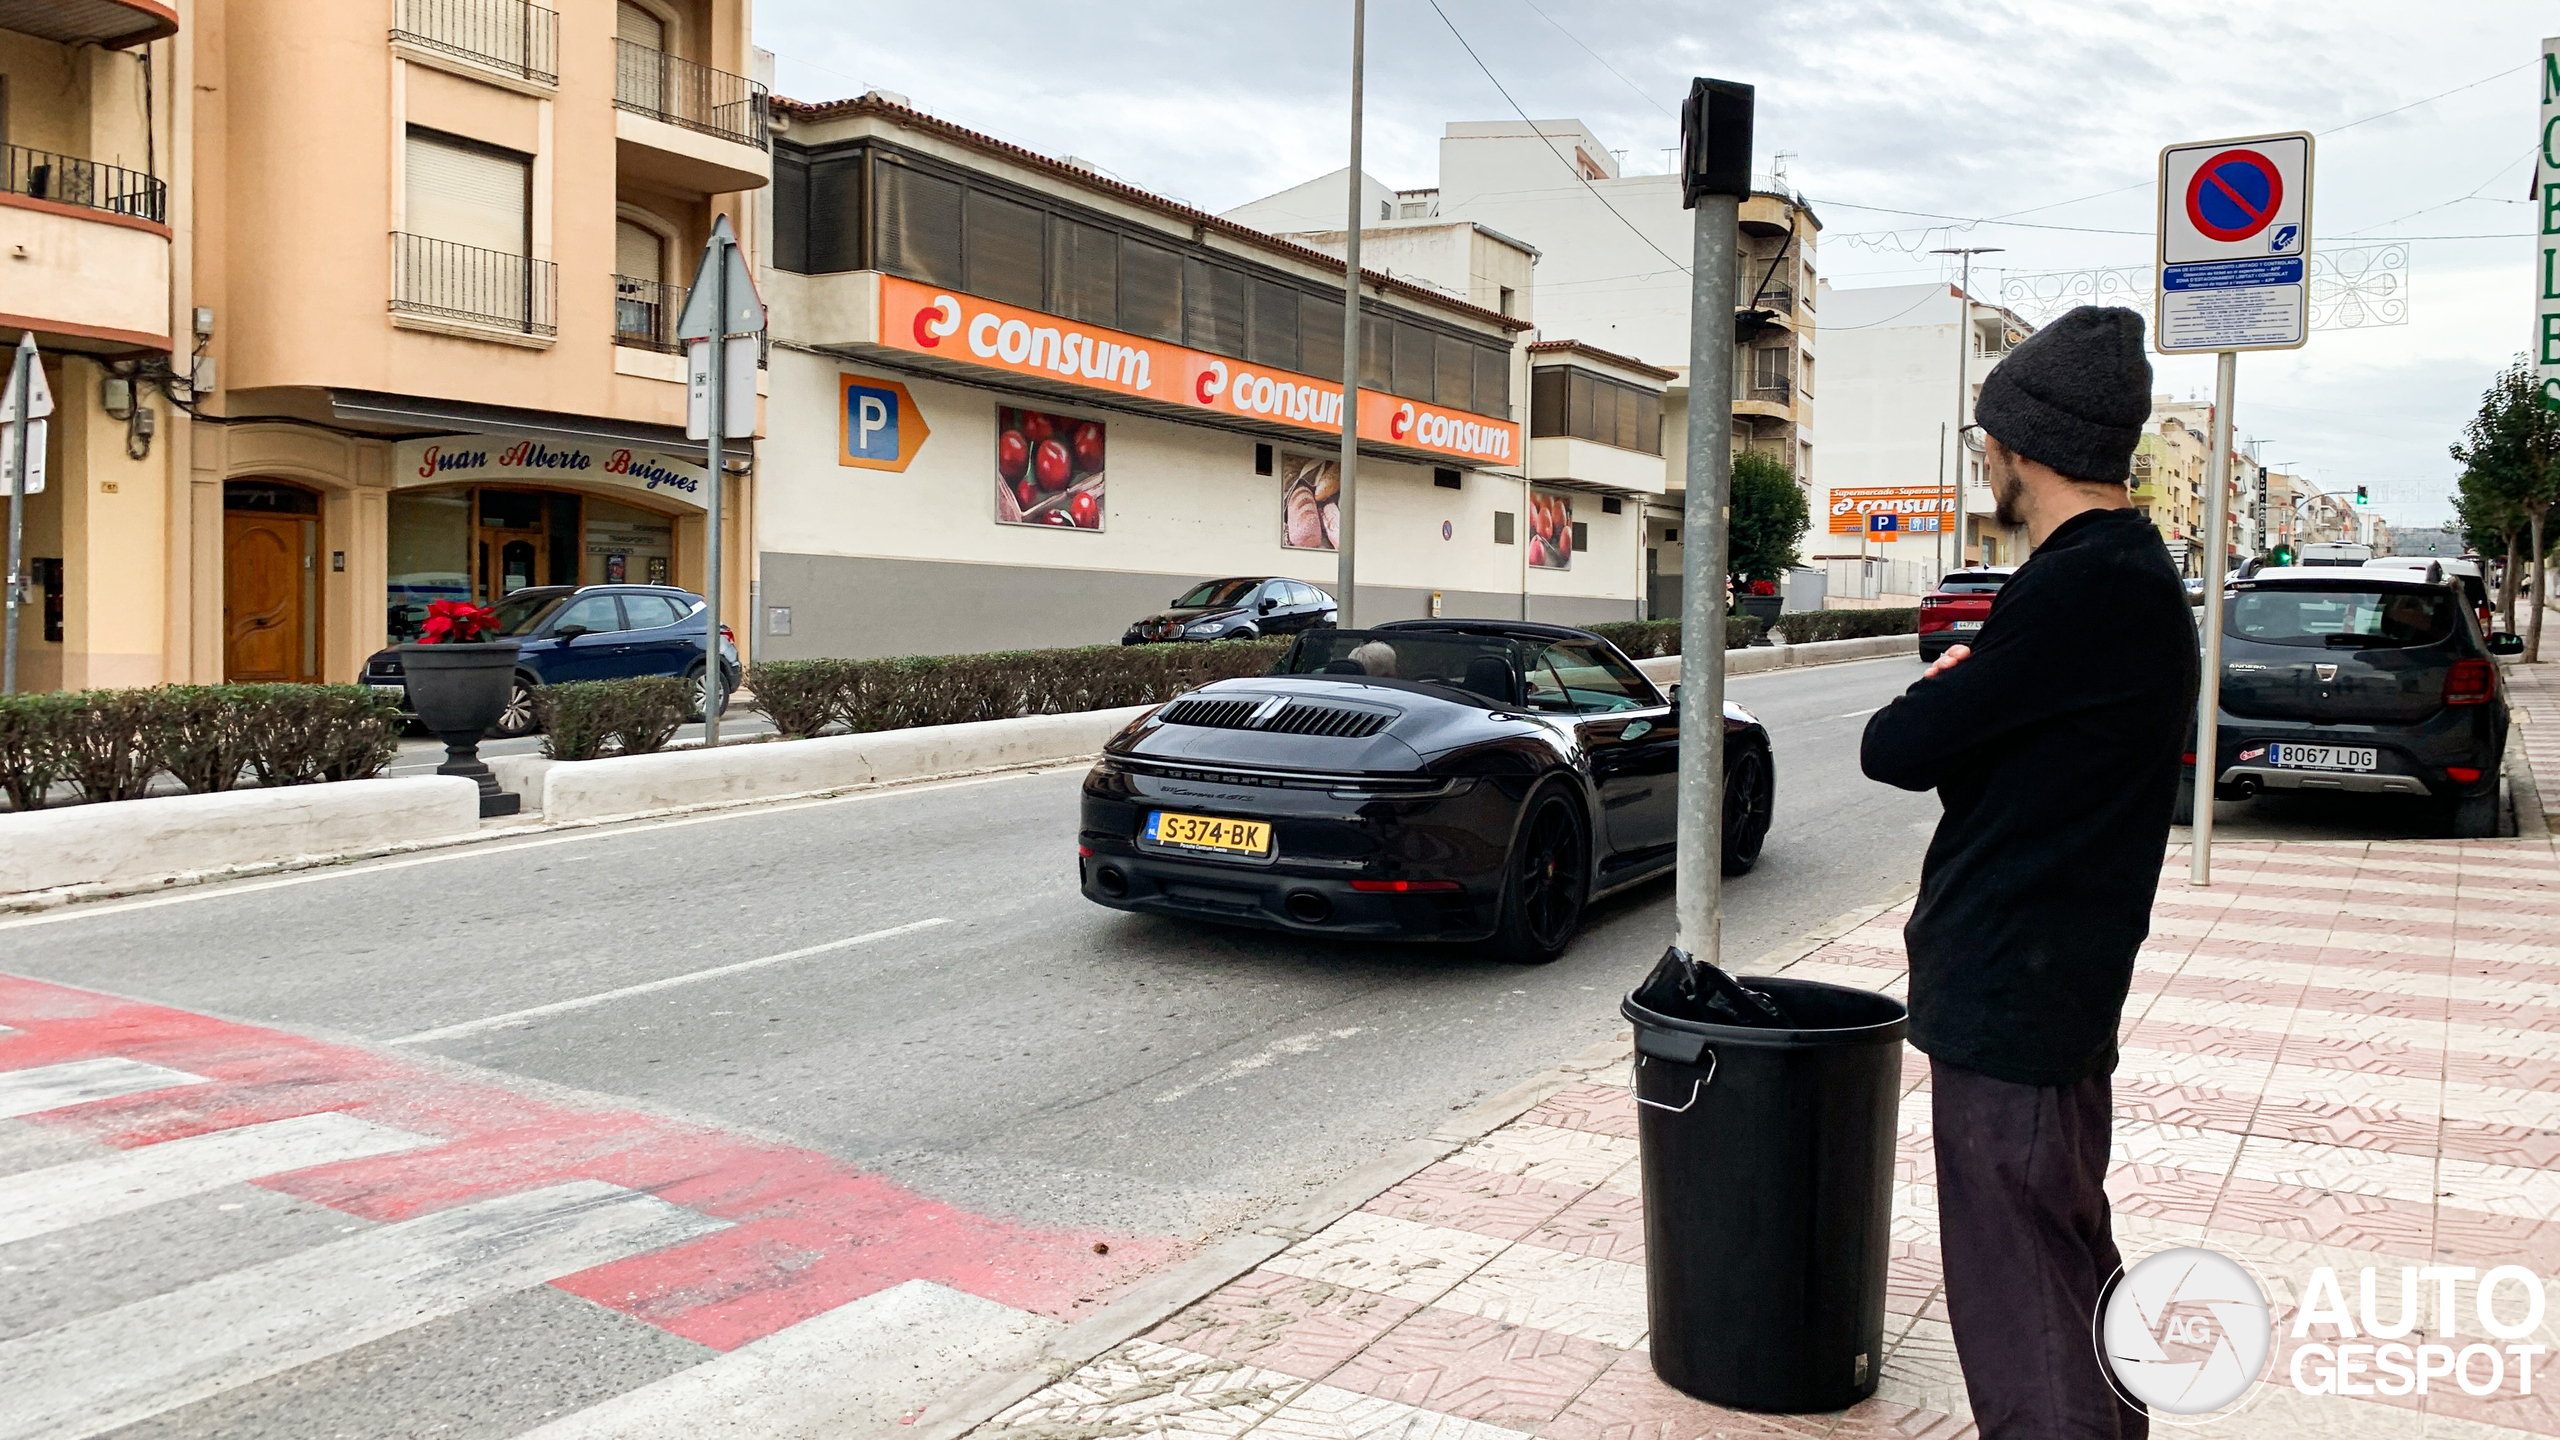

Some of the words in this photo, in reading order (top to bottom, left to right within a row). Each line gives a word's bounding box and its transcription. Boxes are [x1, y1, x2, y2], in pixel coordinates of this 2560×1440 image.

[968, 313, 1152, 391] consum
[860, 395, 887, 449] P
[1417, 412, 1510, 459] consum
[419, 446, 488, 478] Juan
[500, 441, 591, 470] Alberto
[605, 449, 698, 492] Buigues
[2283, 747, 2330, 764] 8067
[2336, 750, 2372, 766] LDG
[1165, 817, 1259, 848] S-374-BK
